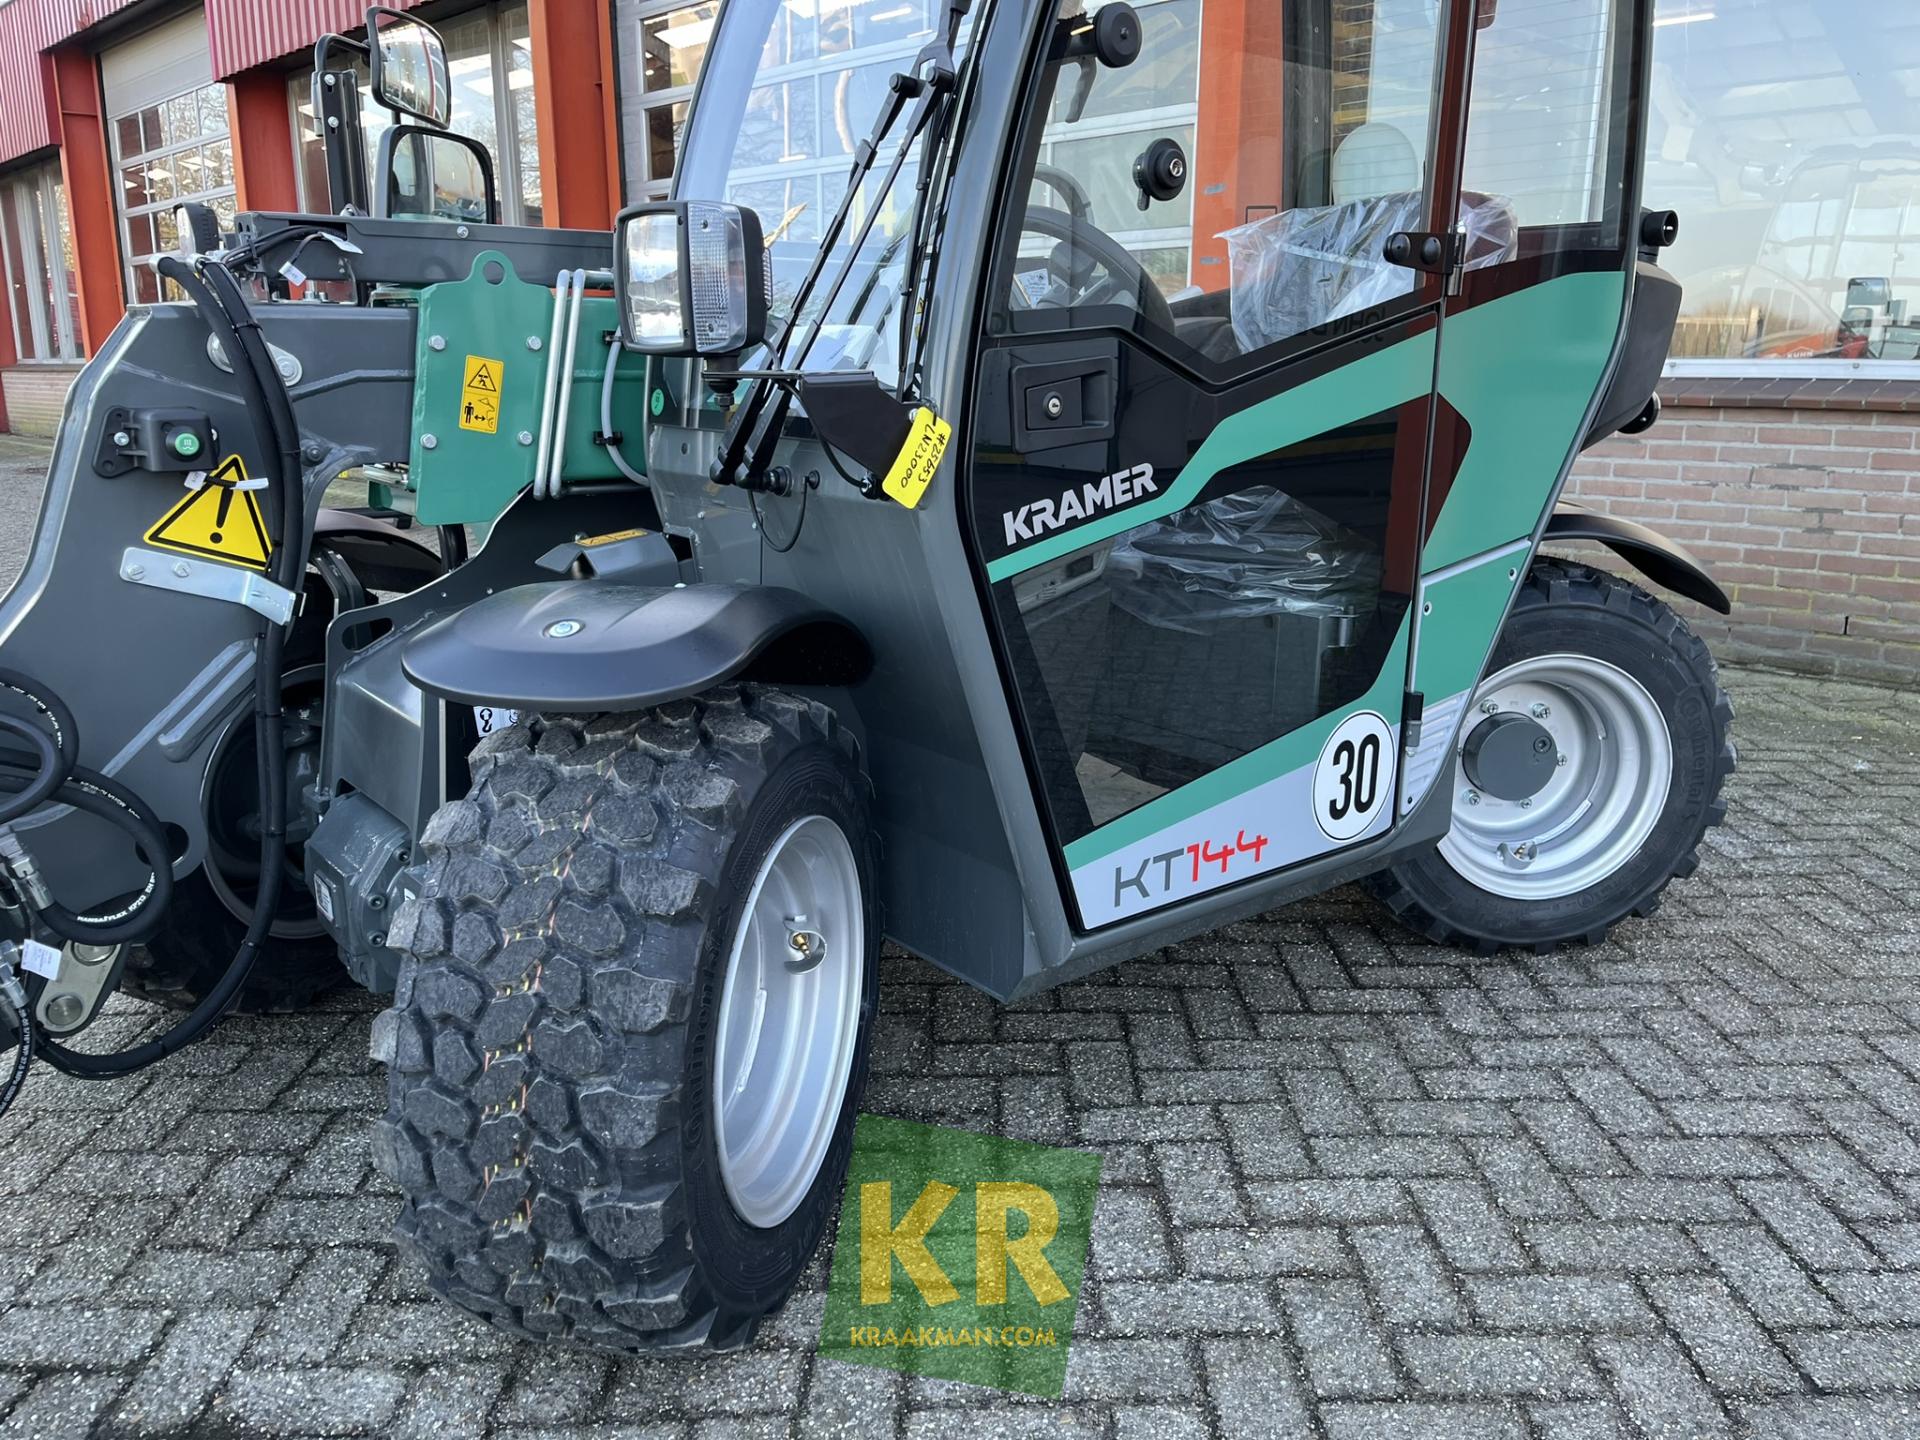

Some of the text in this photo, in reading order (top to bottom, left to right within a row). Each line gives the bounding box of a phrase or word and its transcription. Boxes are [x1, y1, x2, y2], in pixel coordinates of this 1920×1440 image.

[901, 424, 935, 488] LN23000
[1003, 463, 1158, 546] KRAMER
[1329, 734, 1380, 820] 30
[1114, 830, 1268, 907] KT144
